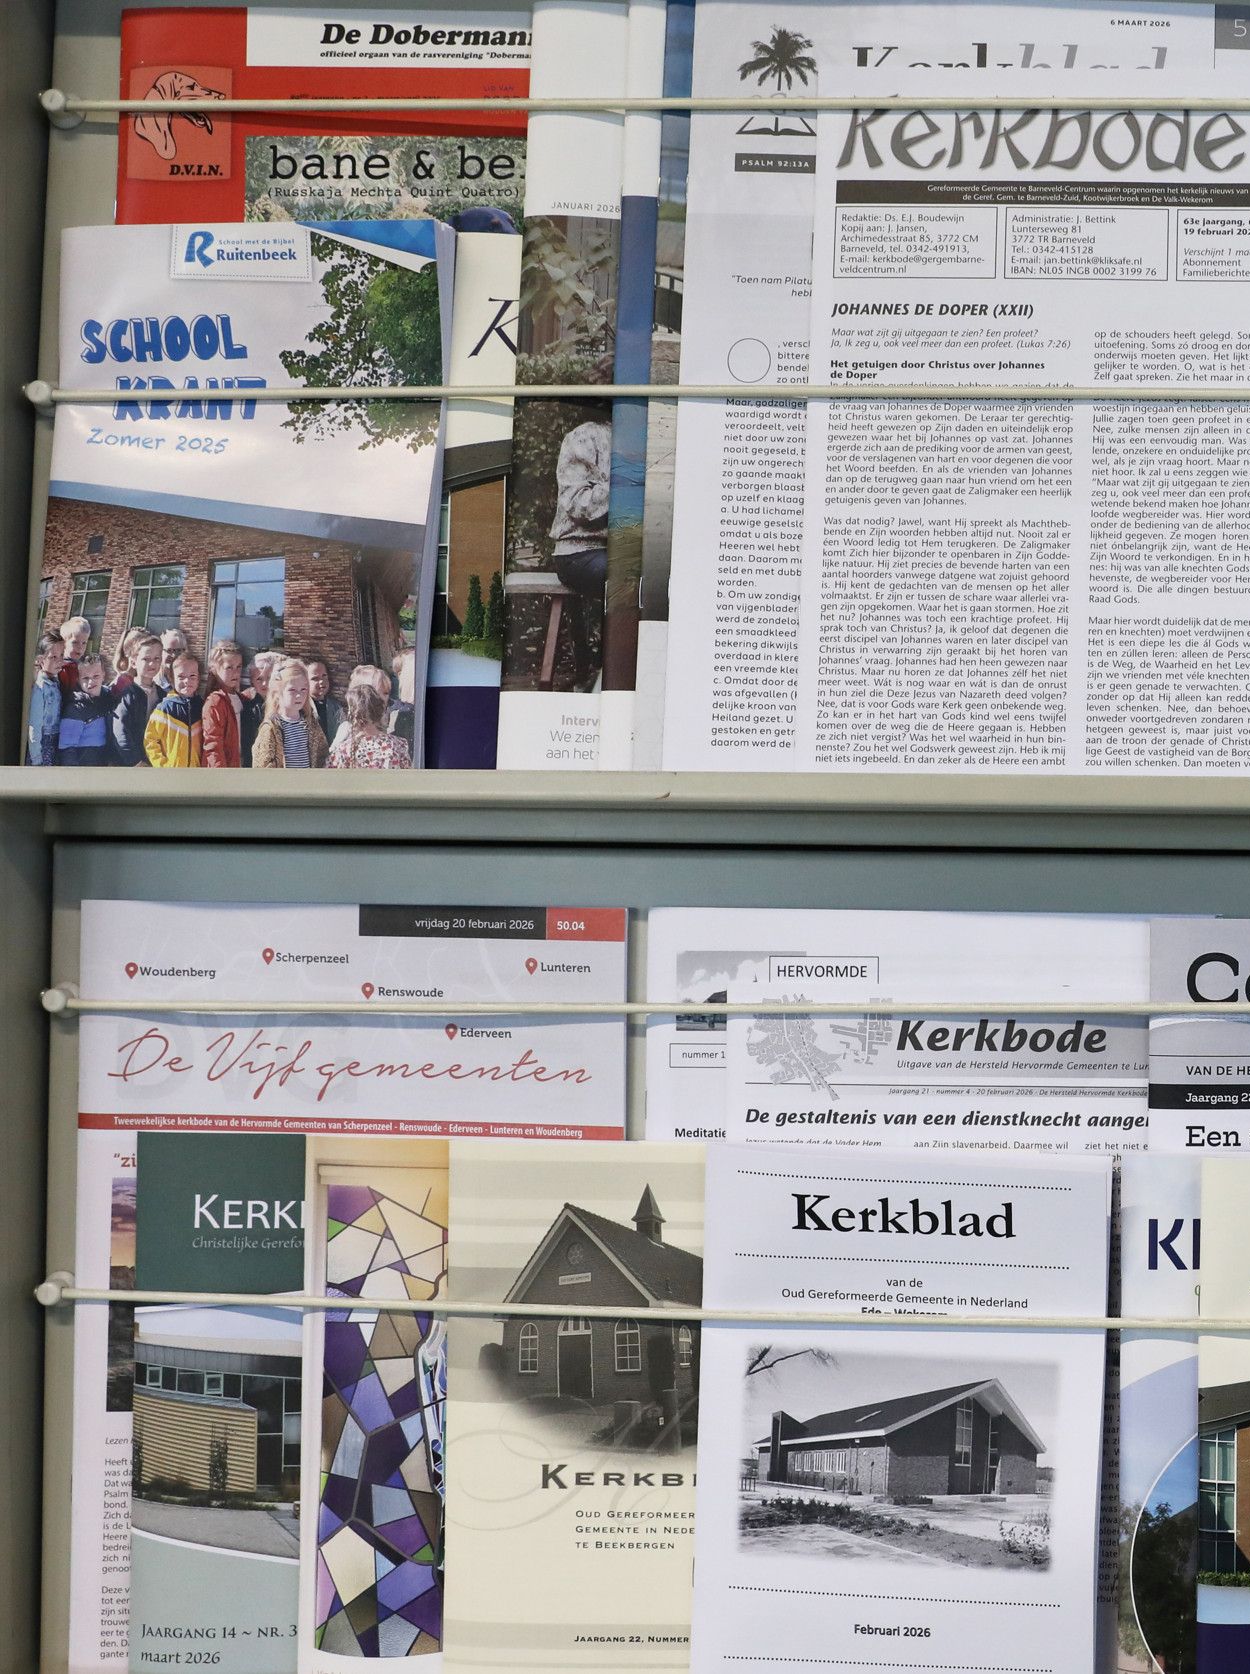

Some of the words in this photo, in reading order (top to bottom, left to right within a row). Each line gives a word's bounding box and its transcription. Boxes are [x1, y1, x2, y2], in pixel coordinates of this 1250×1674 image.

[1148, 19, 1171, 28] 2026
[1231, 18, 1248, 38] 5
[319, 22, 362, 46] De
[368, 23, 533, 47] Doberman
[836, 94, 1248, 172] Kerkbode
[269, 144, 390, 180] bane
[412, 149, 435, 180] &
[167, 163, 225, 179] D.V.I.N.
[266, 186, 344, 200] (Russkaja
[350, 186, 403, 198] Mechta
[409, 186, 453, 199] Quint
[461, 186, 520, 199] Quatro)
[551, 201, 593, 211] JANUARI
[597, 202, 622, 214] 2026
[1011, 213, 1074, 224] Administratie:
[1084, 214, 1117, 224] Bettink
[1182, 216, 1200, 225] 63e
[1201, 217, 1245, 227] Jaargang,
[1011, 224, 1069, 236] Lunterseweg
[1070, 224, 1081, 234] 81
[1196, 227, 1234, 236] februari
[215, 247, 298, 262] Ruitenbeek
[830, 302, 910, 318] JOHANNES
[913, 303, 934, 316] DE
[937, 303, 989, 316] DOPER
[992, 303, 1034, 319] (XXII)
[80, 314, 248, 364] SCHOOL
[112, 376, 267, 422] KRANT
[85, 426, 167, 451] Zomer
[175, 434, 230, 455] 2025
[413, 917, 450, 931] vrijdag
[451, 917, 466, 929] 20
[467, 918, 507, 929] februari
[508, 918, 535, 930] 2026
[555, 919, 587, 933] 50.04
[275, 951, 349, 965] Scherpenzeel
[140, 965, 216, 980] Woudenberg
[539, 961, 591, 973] Lunteren
[776, 964, 868, 978] HERVORMDE
[377, 985, 444, 998] Renswoude
[457, 1024, 515, 1039] Ederveen
[896, 1019, 1108, 1053] Kerkbode
[107, 1027, 194, 1084] De
[206, 1028, 312, 1101] Vijf
[317, 1048, 593, 1102] gemeenten
[744, 1107, 770, 1123] De
[774, 1108, 877, 1127] gestaltenis
[882, 1113, 917, 1125] van
[922, 1113, 956, 1126] een
[961, 1109, 1082, 1127] dienstknecht
[1184, 1124, 1242, 1147] Een
[193, 1193, 305, 1230] KERK
[791, 1192, 1016, 1242] Kerkblad
[885, 1278, 906, 1287] van
[908, 1276, 923, 1288] de
[781, 1287, 805, 1299] Oud
[807, 1288, 893, 1303] Gereformeerde
[895, 1292, 954, 1306] Gemeente
[956, 1294, 967, 1306] in
[970, 1295, 1028, 1309] Nederland
[594, 1540, 675, 1550] BEEKBERGEN
[141, 1622, 216, 1639] JAARGANG
[221, 1625, 237, 1639] 14
[256, 1626, 284, 1638] NR.
[288, 1623, 298, 1638] 3
[853, 1623, 900, 1637] Februari
[902, 1626, 931, 1638] 2026
[573, 1634, 626, 1643] JAARGANG
[140, 1651, 182, 1664] maart
[184, 1650, 221, 1665] 2026
